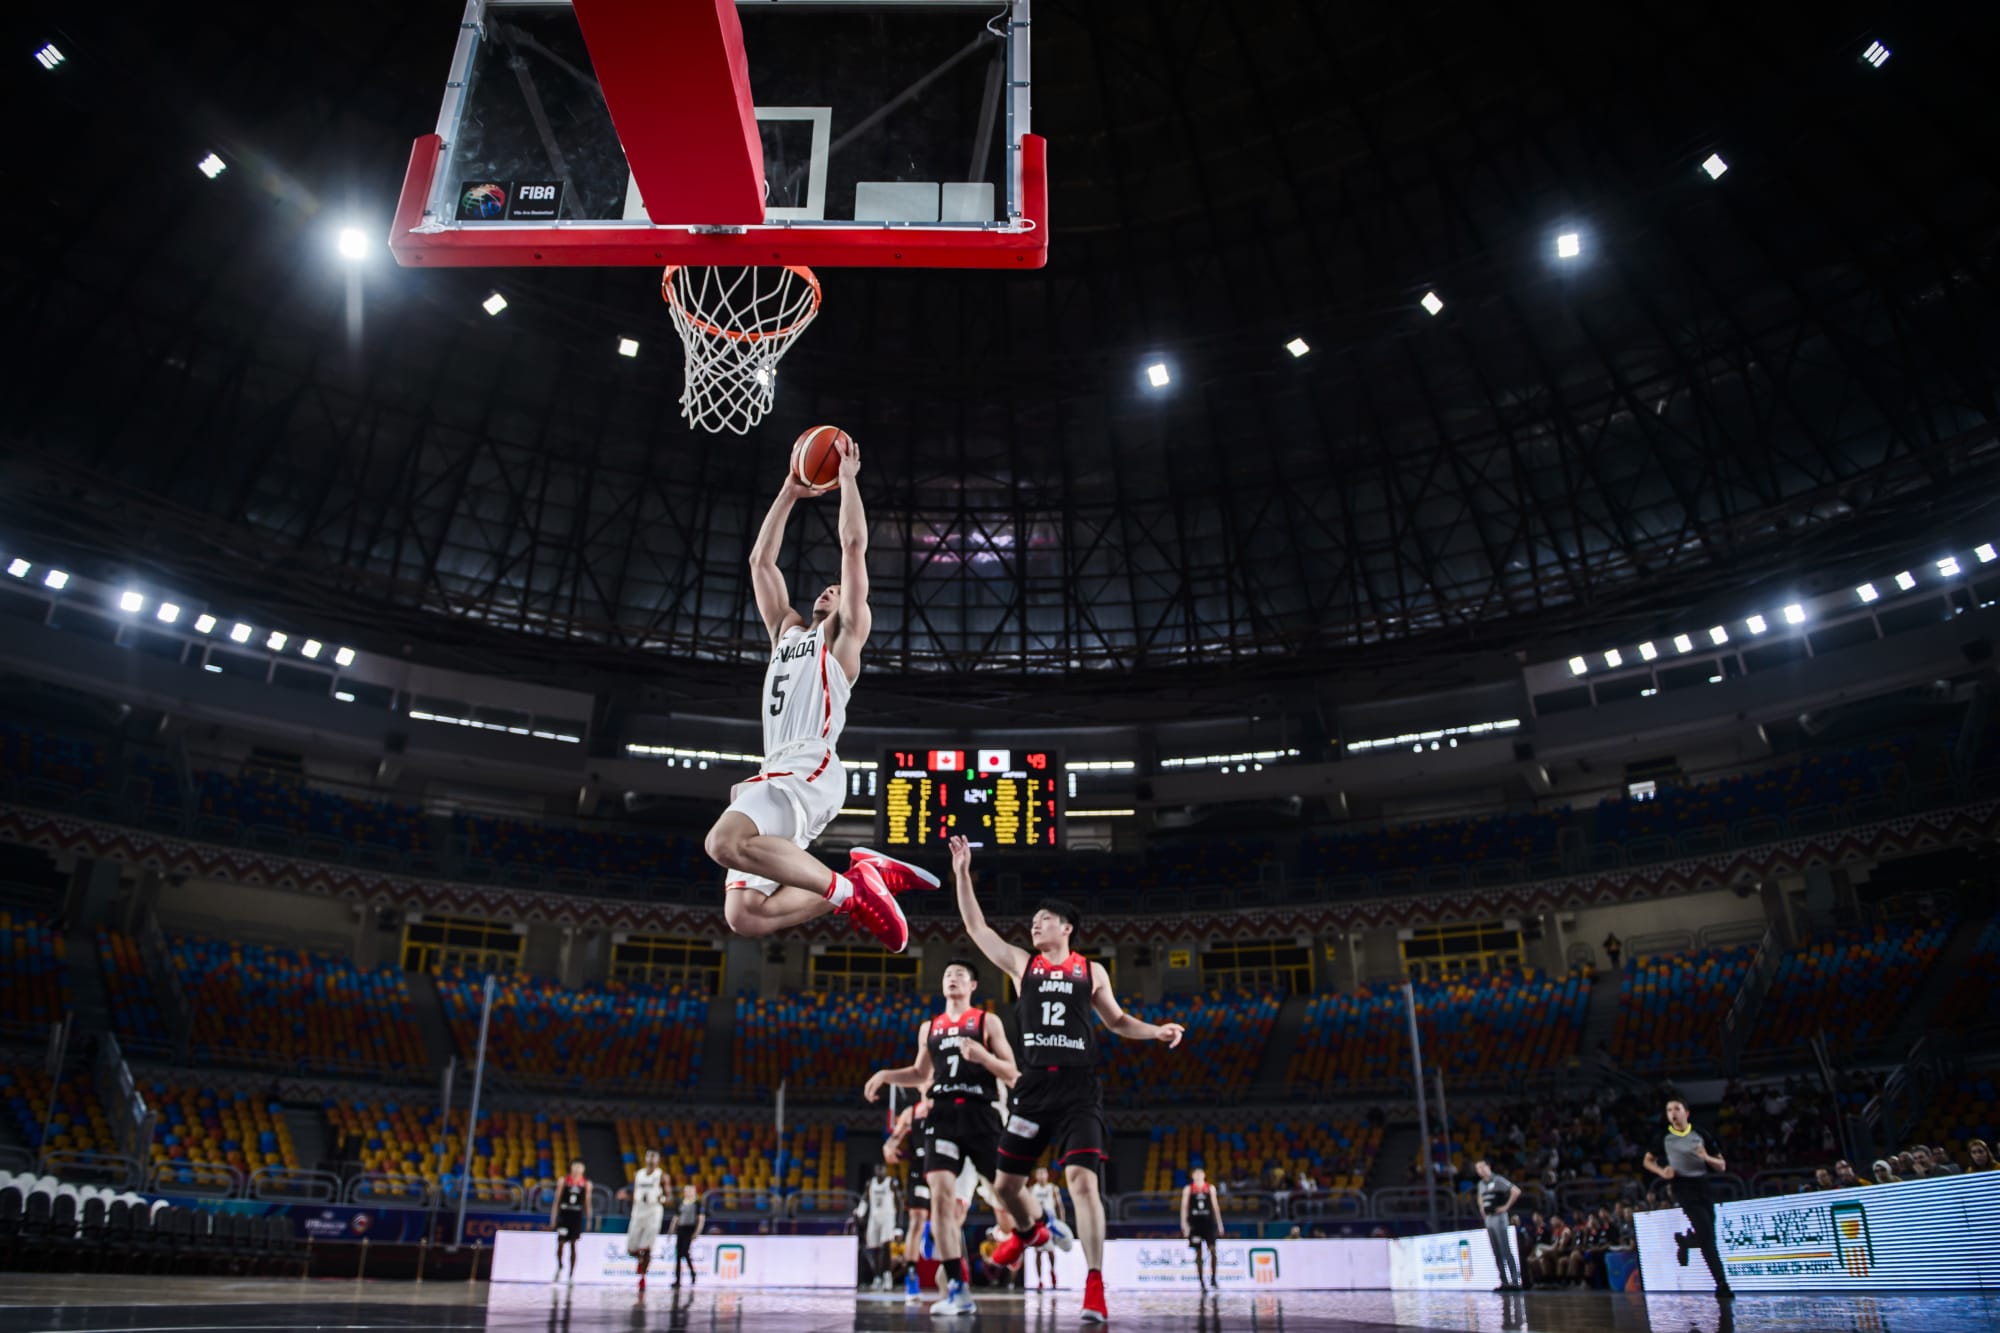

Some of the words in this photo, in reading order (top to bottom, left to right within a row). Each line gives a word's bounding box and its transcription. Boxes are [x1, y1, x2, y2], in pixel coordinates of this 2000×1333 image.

[519, 185, 556, 200] FIBA
[772, 640, 815, 664] NADA
[769, 674, 790, 717] 5
[894, 752, 914, 768] 71
[1026, 753, 1047, 770] 49
[1038, 979, 1073, 995] JAPAN
[1040, 1001, 1066, 1027] 12
[939, 1036, 963, 1051] JAPA
[1035, 1033, 1086, 1050] SoftBank
[946, 1054, 959, 1079] 7
